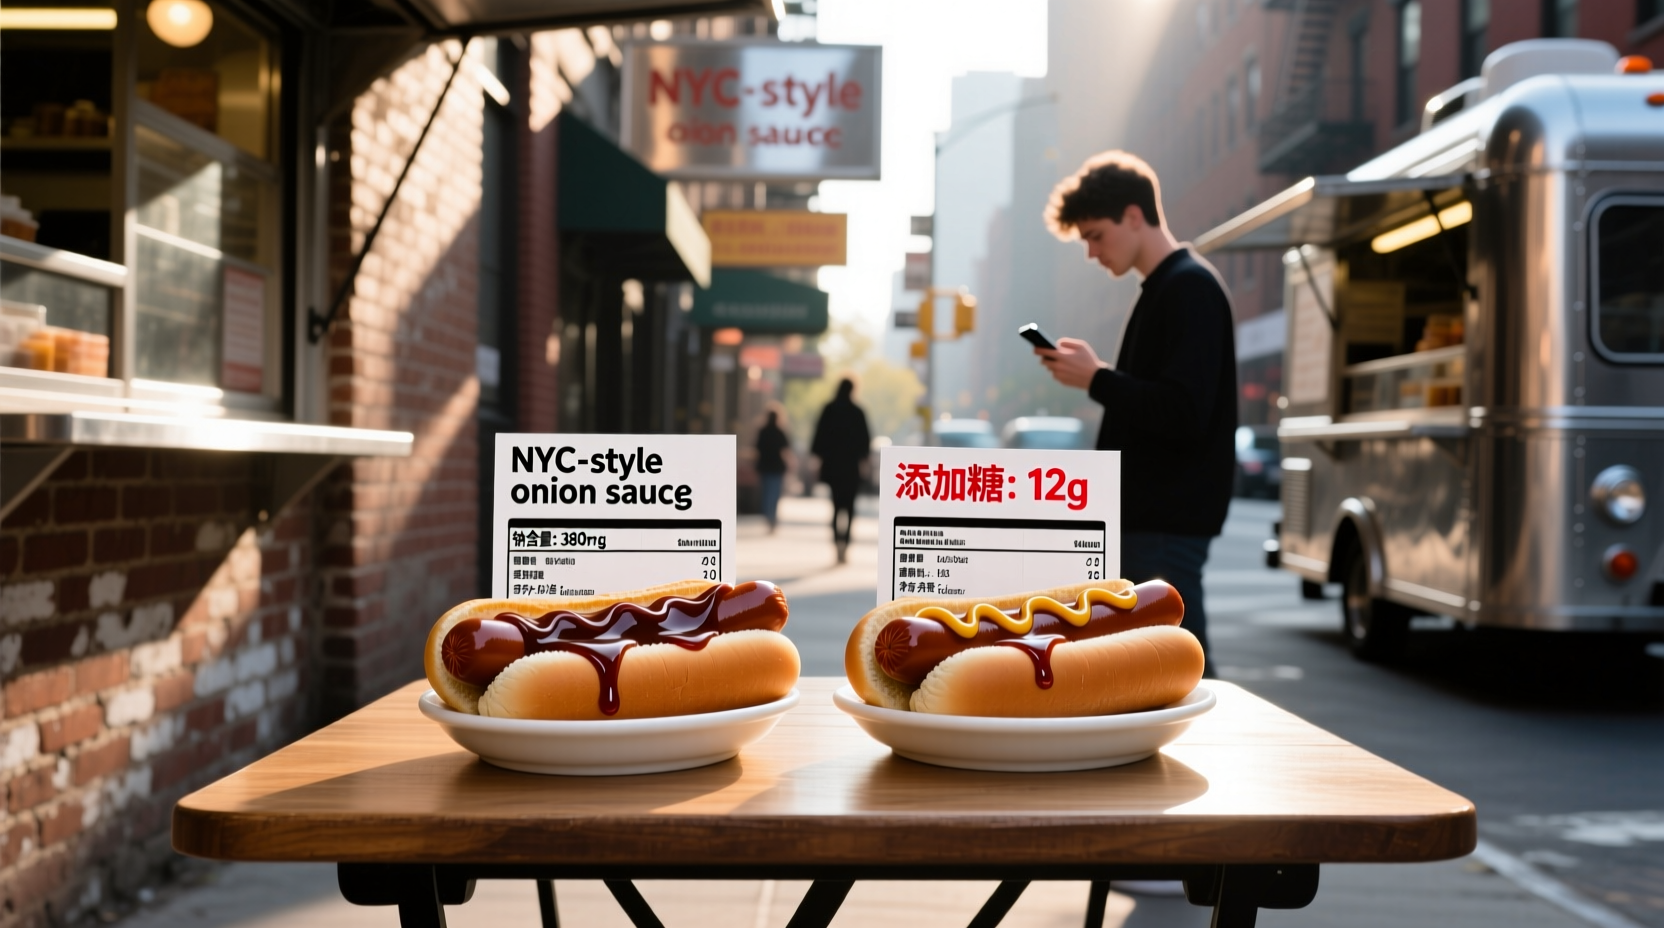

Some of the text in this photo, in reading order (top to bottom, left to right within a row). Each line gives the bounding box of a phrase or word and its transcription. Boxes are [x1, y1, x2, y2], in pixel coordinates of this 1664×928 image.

[648, 66, 863, 118] NYC-style
[511, 446, 663, 481] NYC-style
[511, 476, 597, 504] onion
[1028, 468, 1088, 511] 12g
